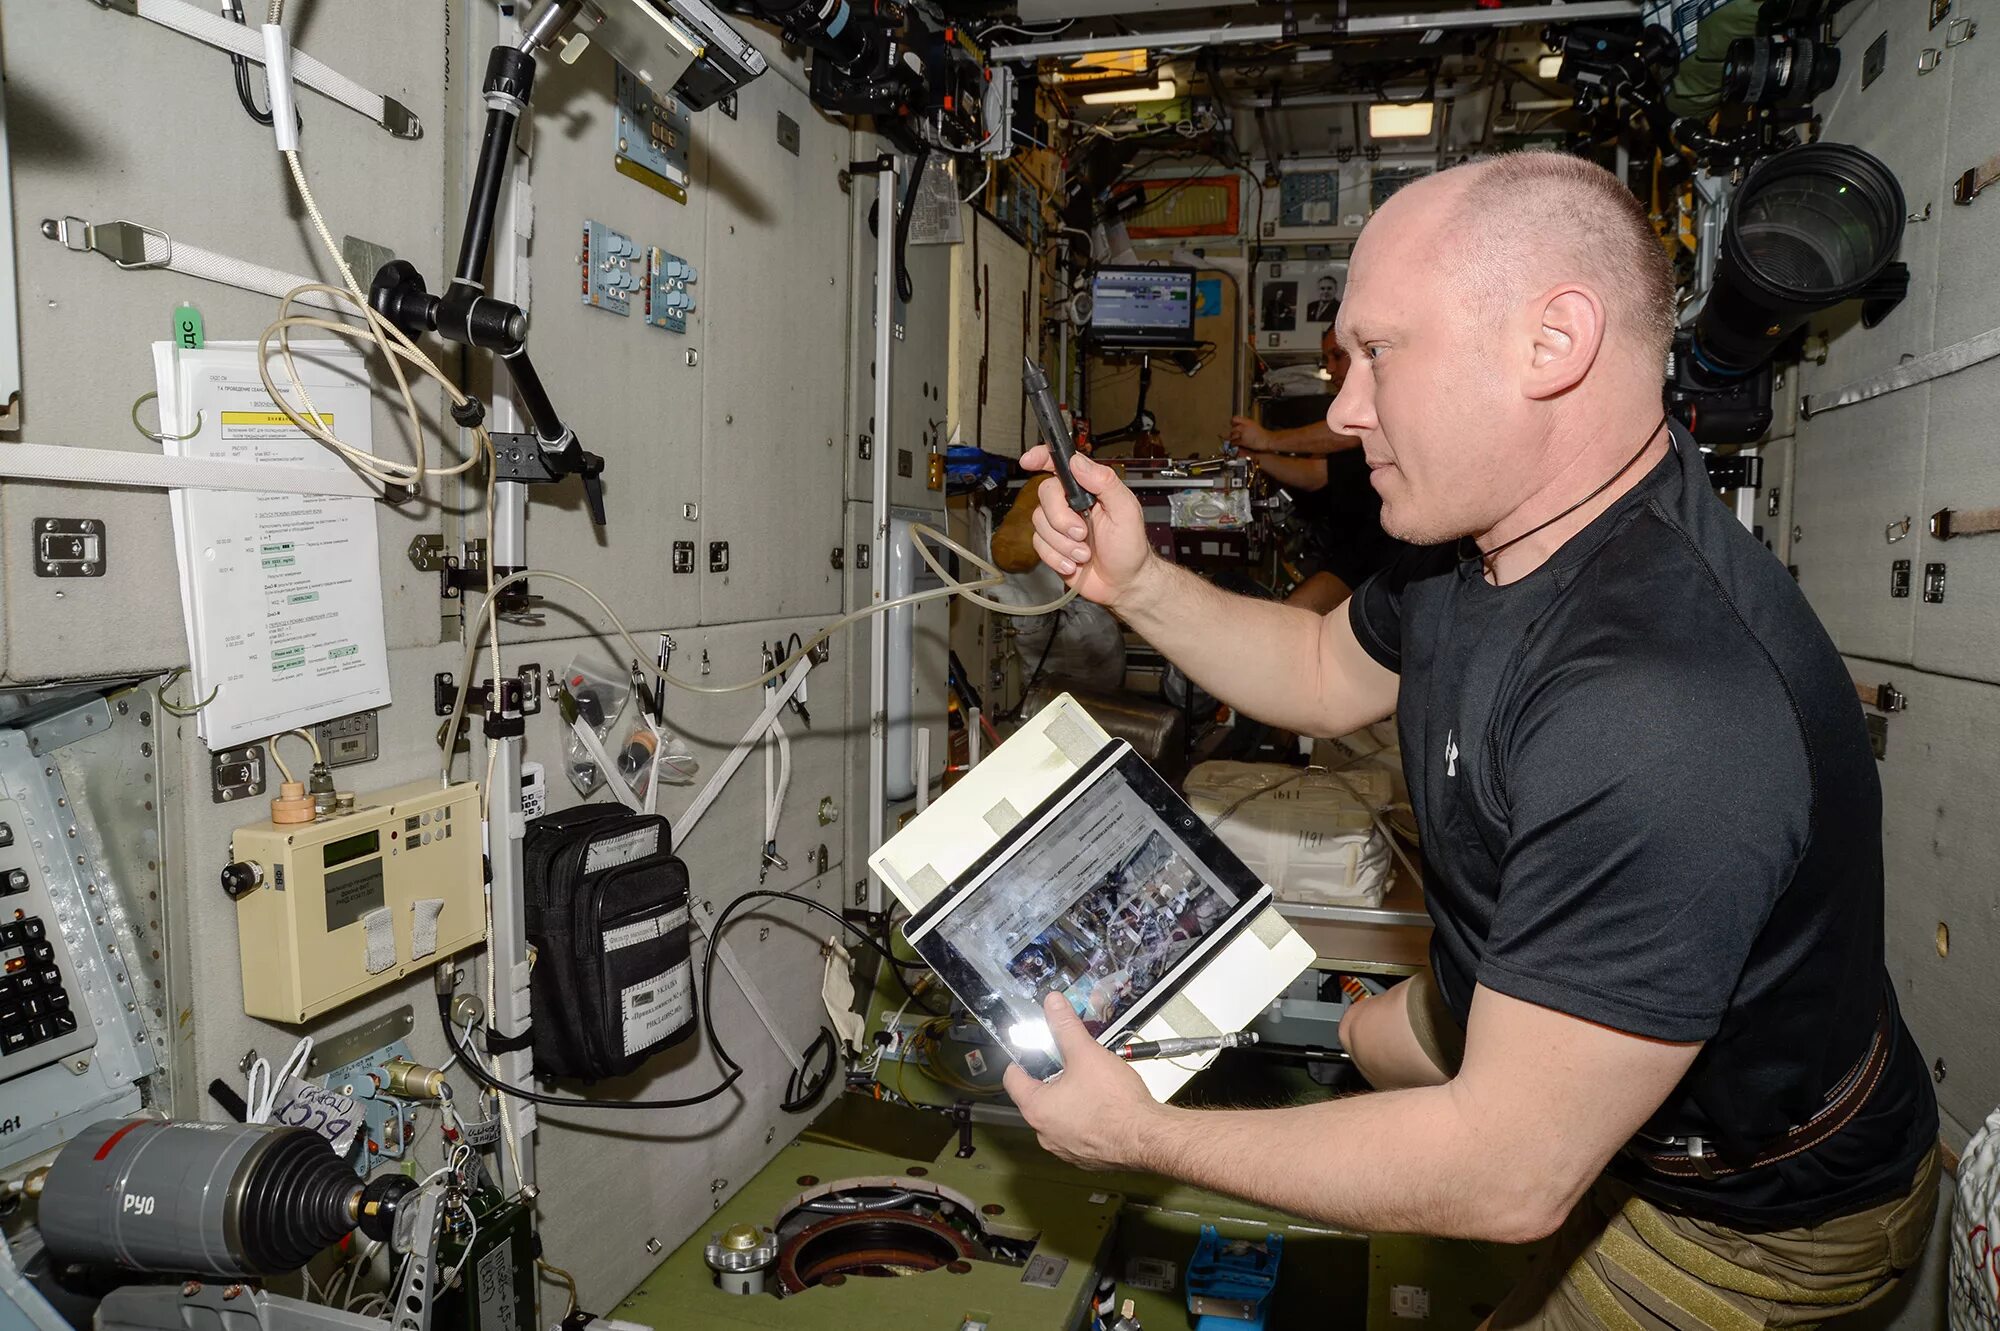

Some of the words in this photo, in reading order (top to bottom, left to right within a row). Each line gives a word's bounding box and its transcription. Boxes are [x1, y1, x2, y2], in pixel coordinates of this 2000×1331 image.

[888, 41, 897, 66] Nikon
[1666, 351, 1676, 376] Nikon
[1297, 829, 1325, 849] 1191
